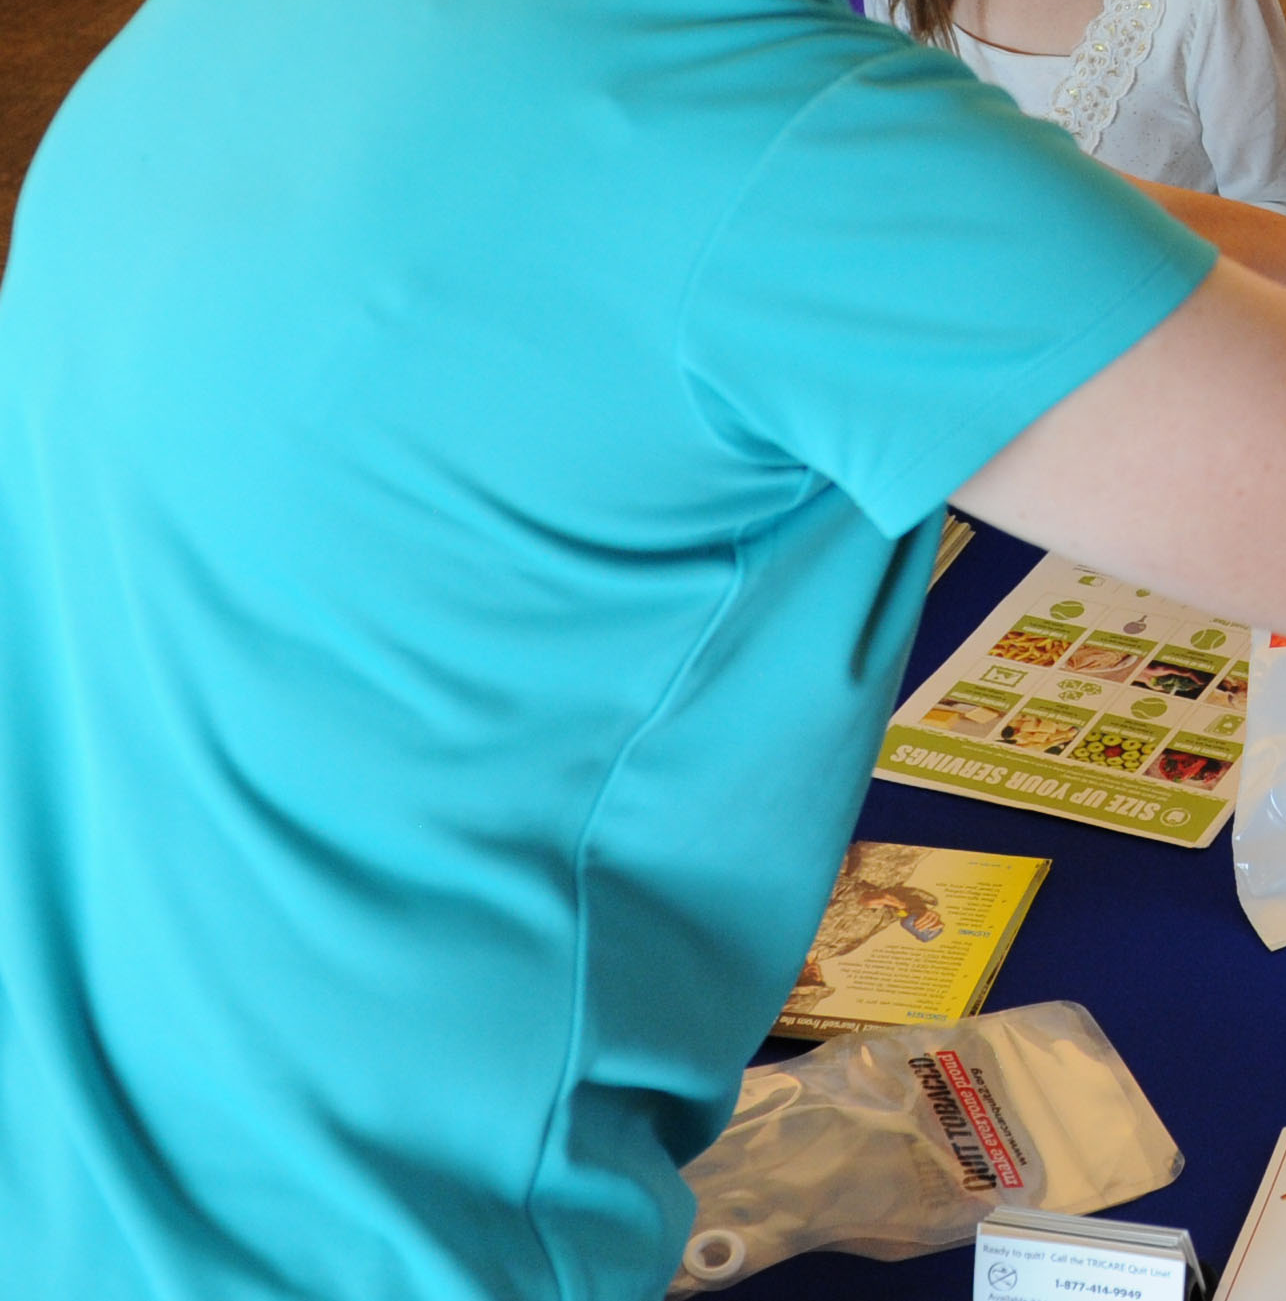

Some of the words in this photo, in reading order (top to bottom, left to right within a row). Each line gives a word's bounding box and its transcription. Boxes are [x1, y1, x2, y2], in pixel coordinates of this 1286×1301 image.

[889, 744, 1008, 785] SERVINGS
[1005, 770, 1072, 801] YOUR
[1069, 788, 1109, 809] UP
[1111, 793, 1160, 821] SIZE
[779, 1016, 796, 1026] the
[797, 1017, 820, 1029] from
[820, 1021, 860, 1033] Yourself
[941, 1053, 972, 1089] proud
[960, 1089, 998, 1147] everyone
[971, 1068, 1028, 1166] www.ucanquit2.org
[952, 1143, 997, 1191] QUIT
[990, 1148, 1019, 1186] make
[983, 1245, 1010, 1259] Ready
[1050, 1253, 1066, 1263] Call
[1070, 1254, 1084, 1265] the
[1087, 1257, 1125, 1273] TRICARE
[1128, 1262, 1147, 1276] Quit
[1055, 1278, 1142, 1300] 1-877-414-9949
